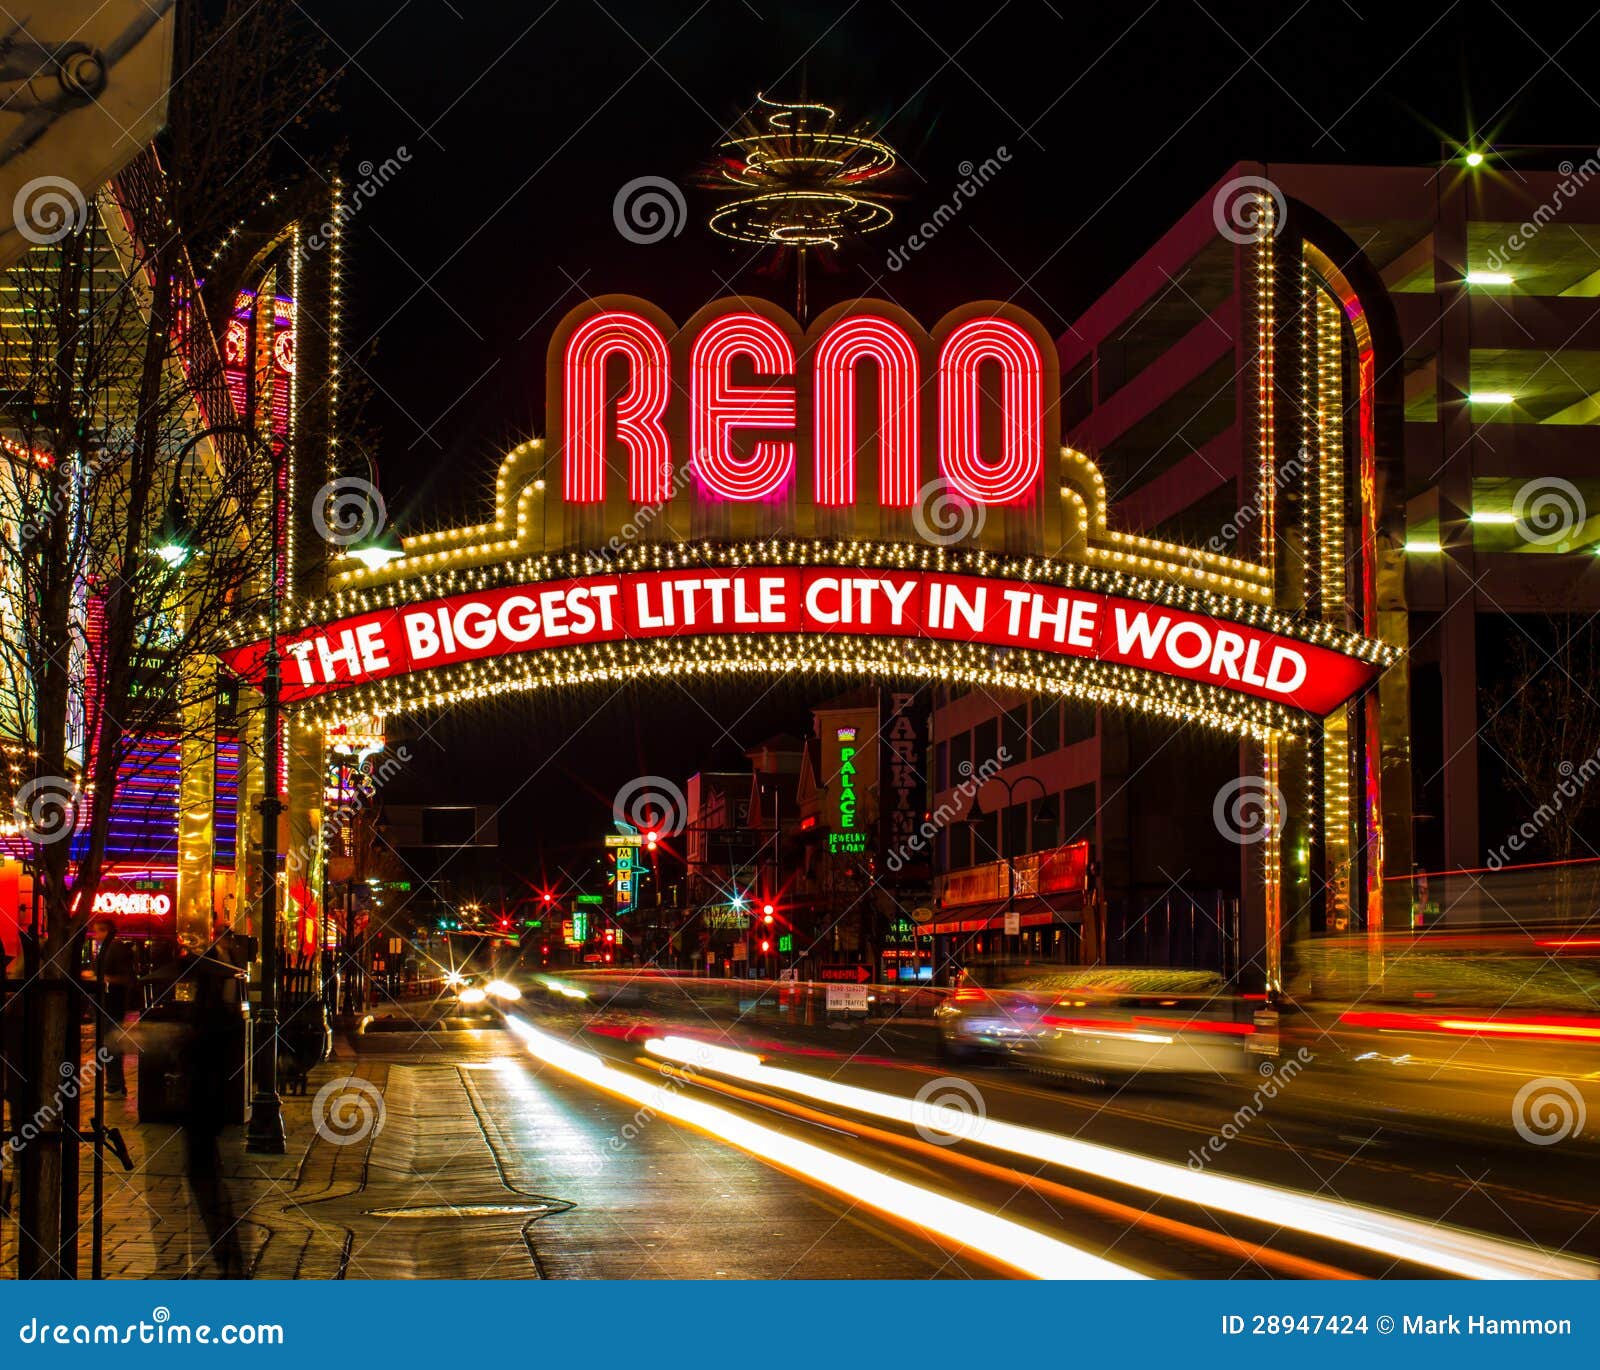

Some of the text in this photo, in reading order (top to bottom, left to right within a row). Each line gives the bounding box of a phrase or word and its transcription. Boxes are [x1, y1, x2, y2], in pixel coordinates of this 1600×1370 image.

[564, 311, 1045, 506] RENO
[286, 577, 1307, 694] THE BIGGEST LITTLE CITY IN THE WORLD
[839, 747, 857, 828] PALACE
[618, 850, 630, 902] MOTEL
